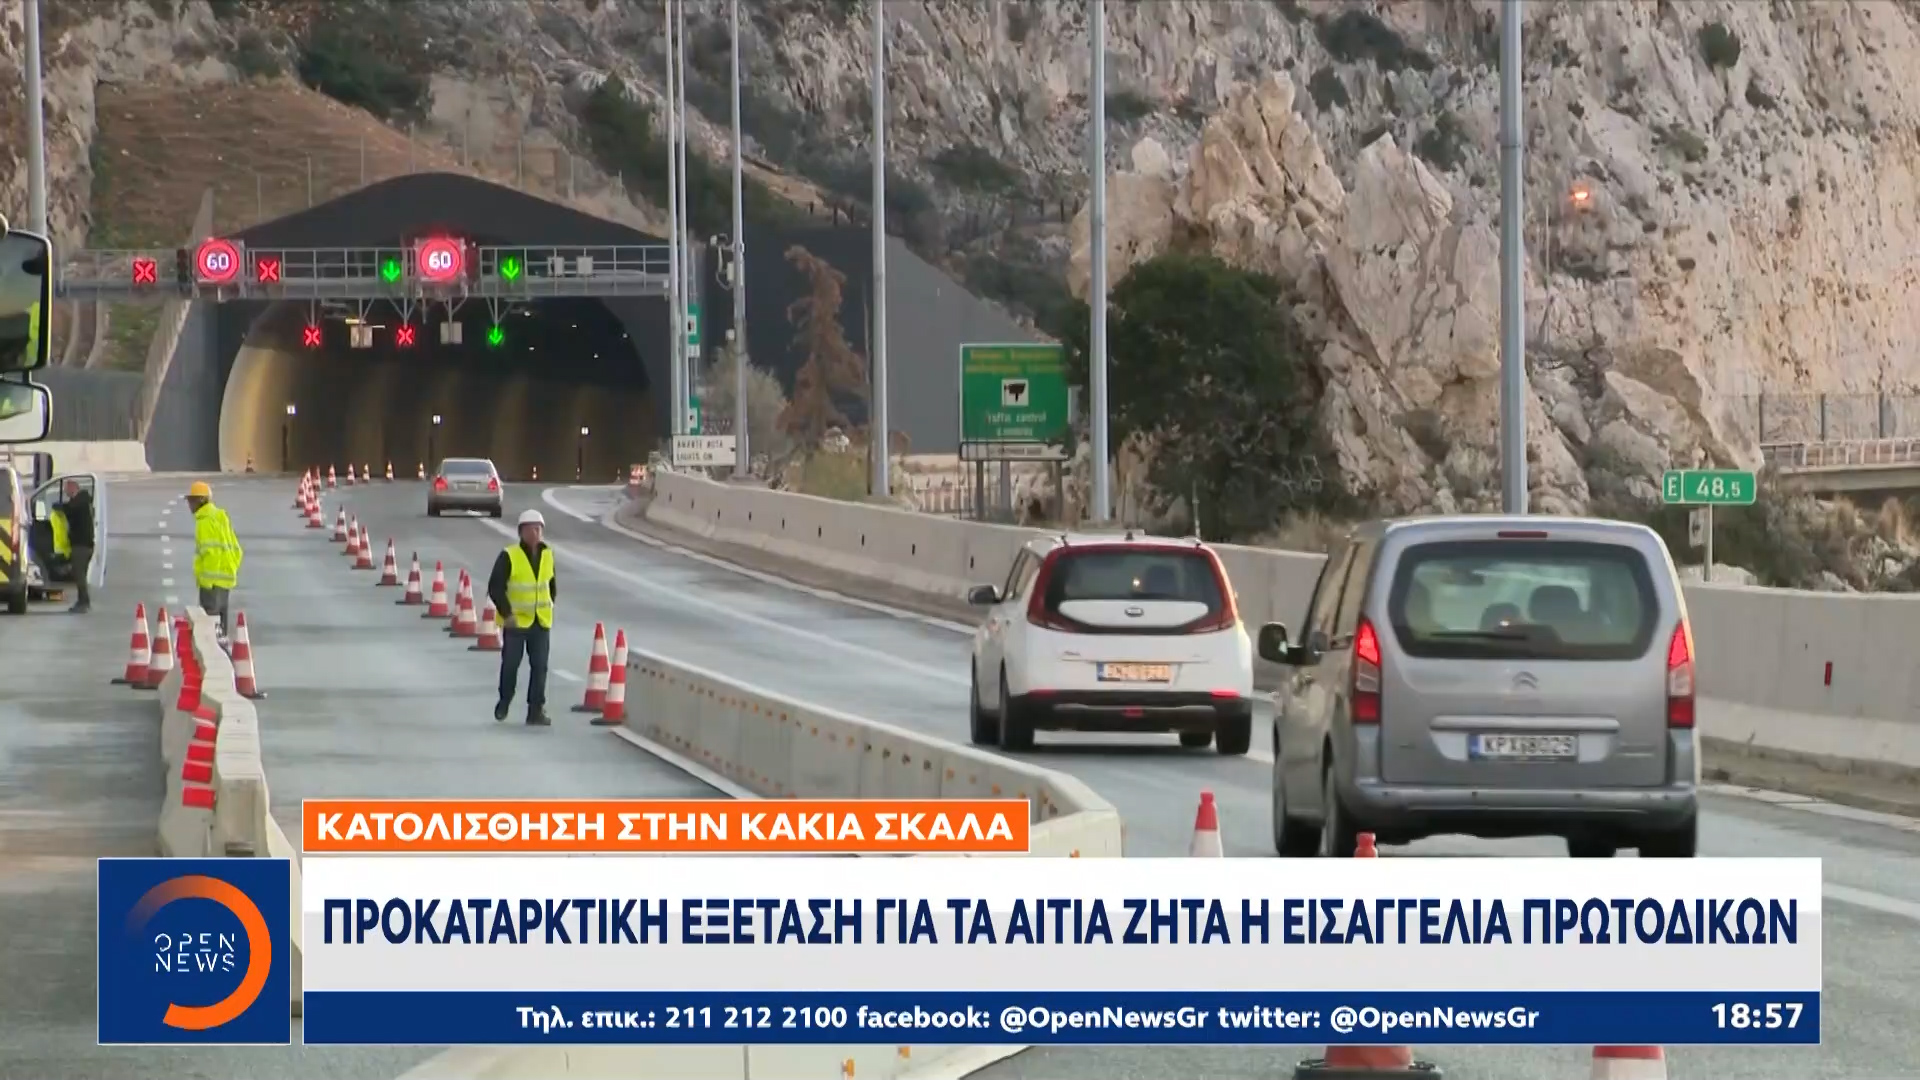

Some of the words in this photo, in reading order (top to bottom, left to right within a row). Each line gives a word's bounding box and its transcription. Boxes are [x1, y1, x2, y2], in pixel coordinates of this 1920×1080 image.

[206, 252, 230, 270] 60
[428, 251, 451, 269] 60
[1668, 476, 1678, 497] E
